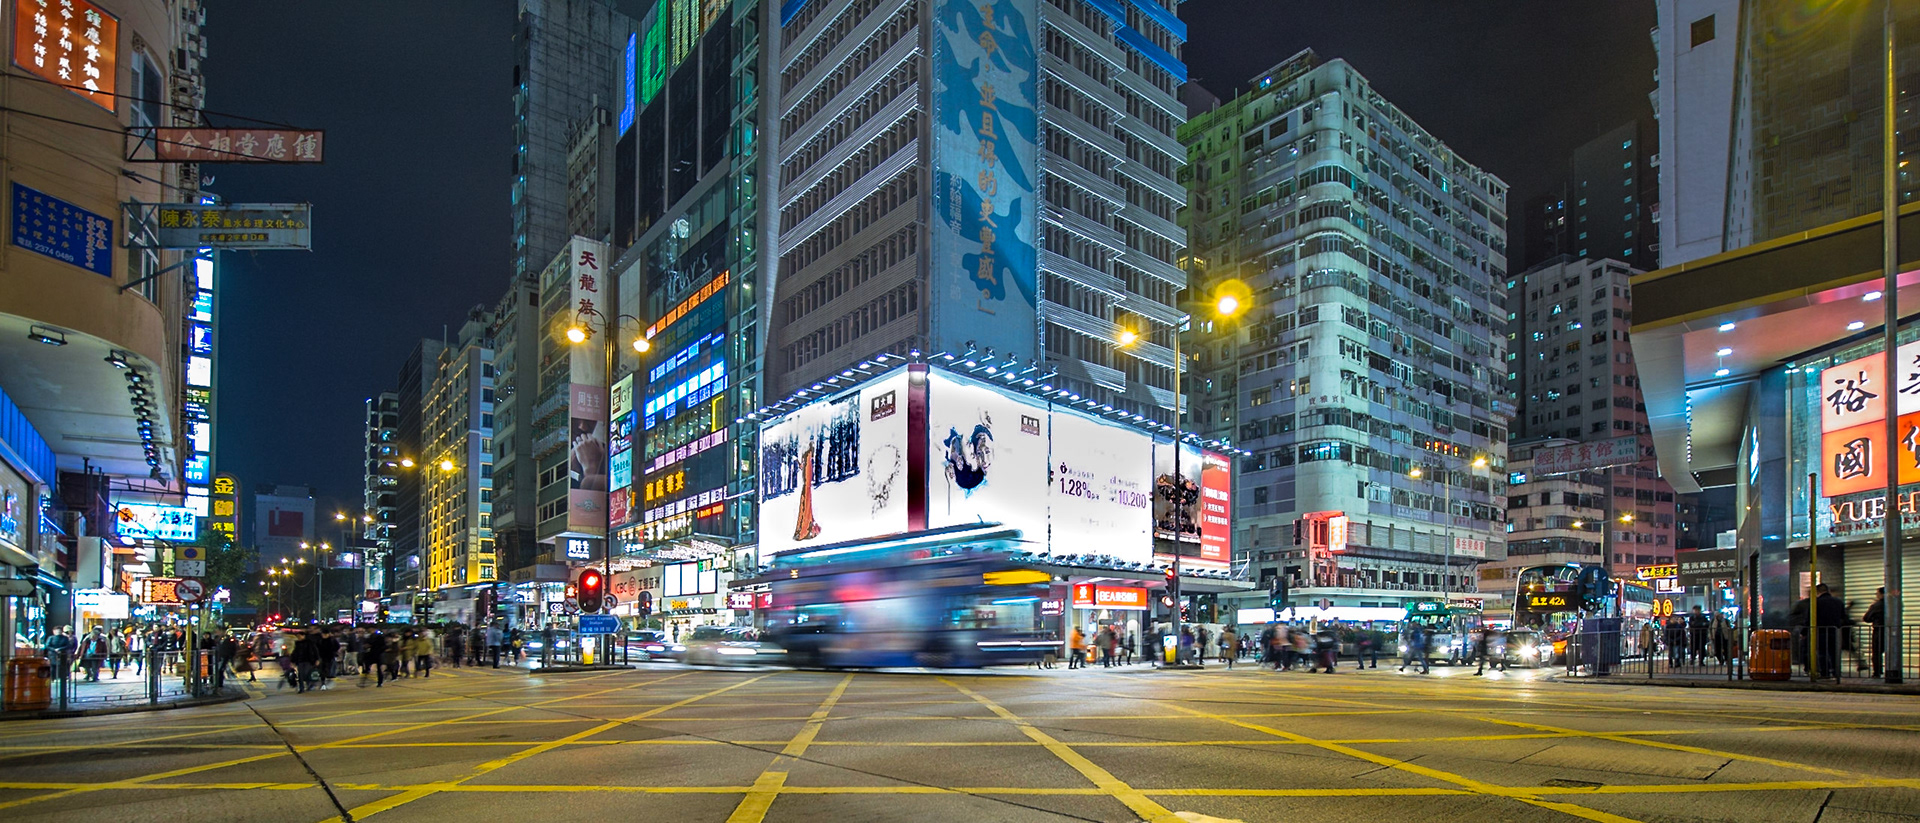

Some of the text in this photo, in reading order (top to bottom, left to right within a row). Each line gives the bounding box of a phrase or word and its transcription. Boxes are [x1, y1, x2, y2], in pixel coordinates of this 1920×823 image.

[35, 243, 54, 255] 2374
[55, 249, 74, 262] 0489
[1830, 497, 1887, 525] YUE
[1549, 596, 1565, 606] 42A
